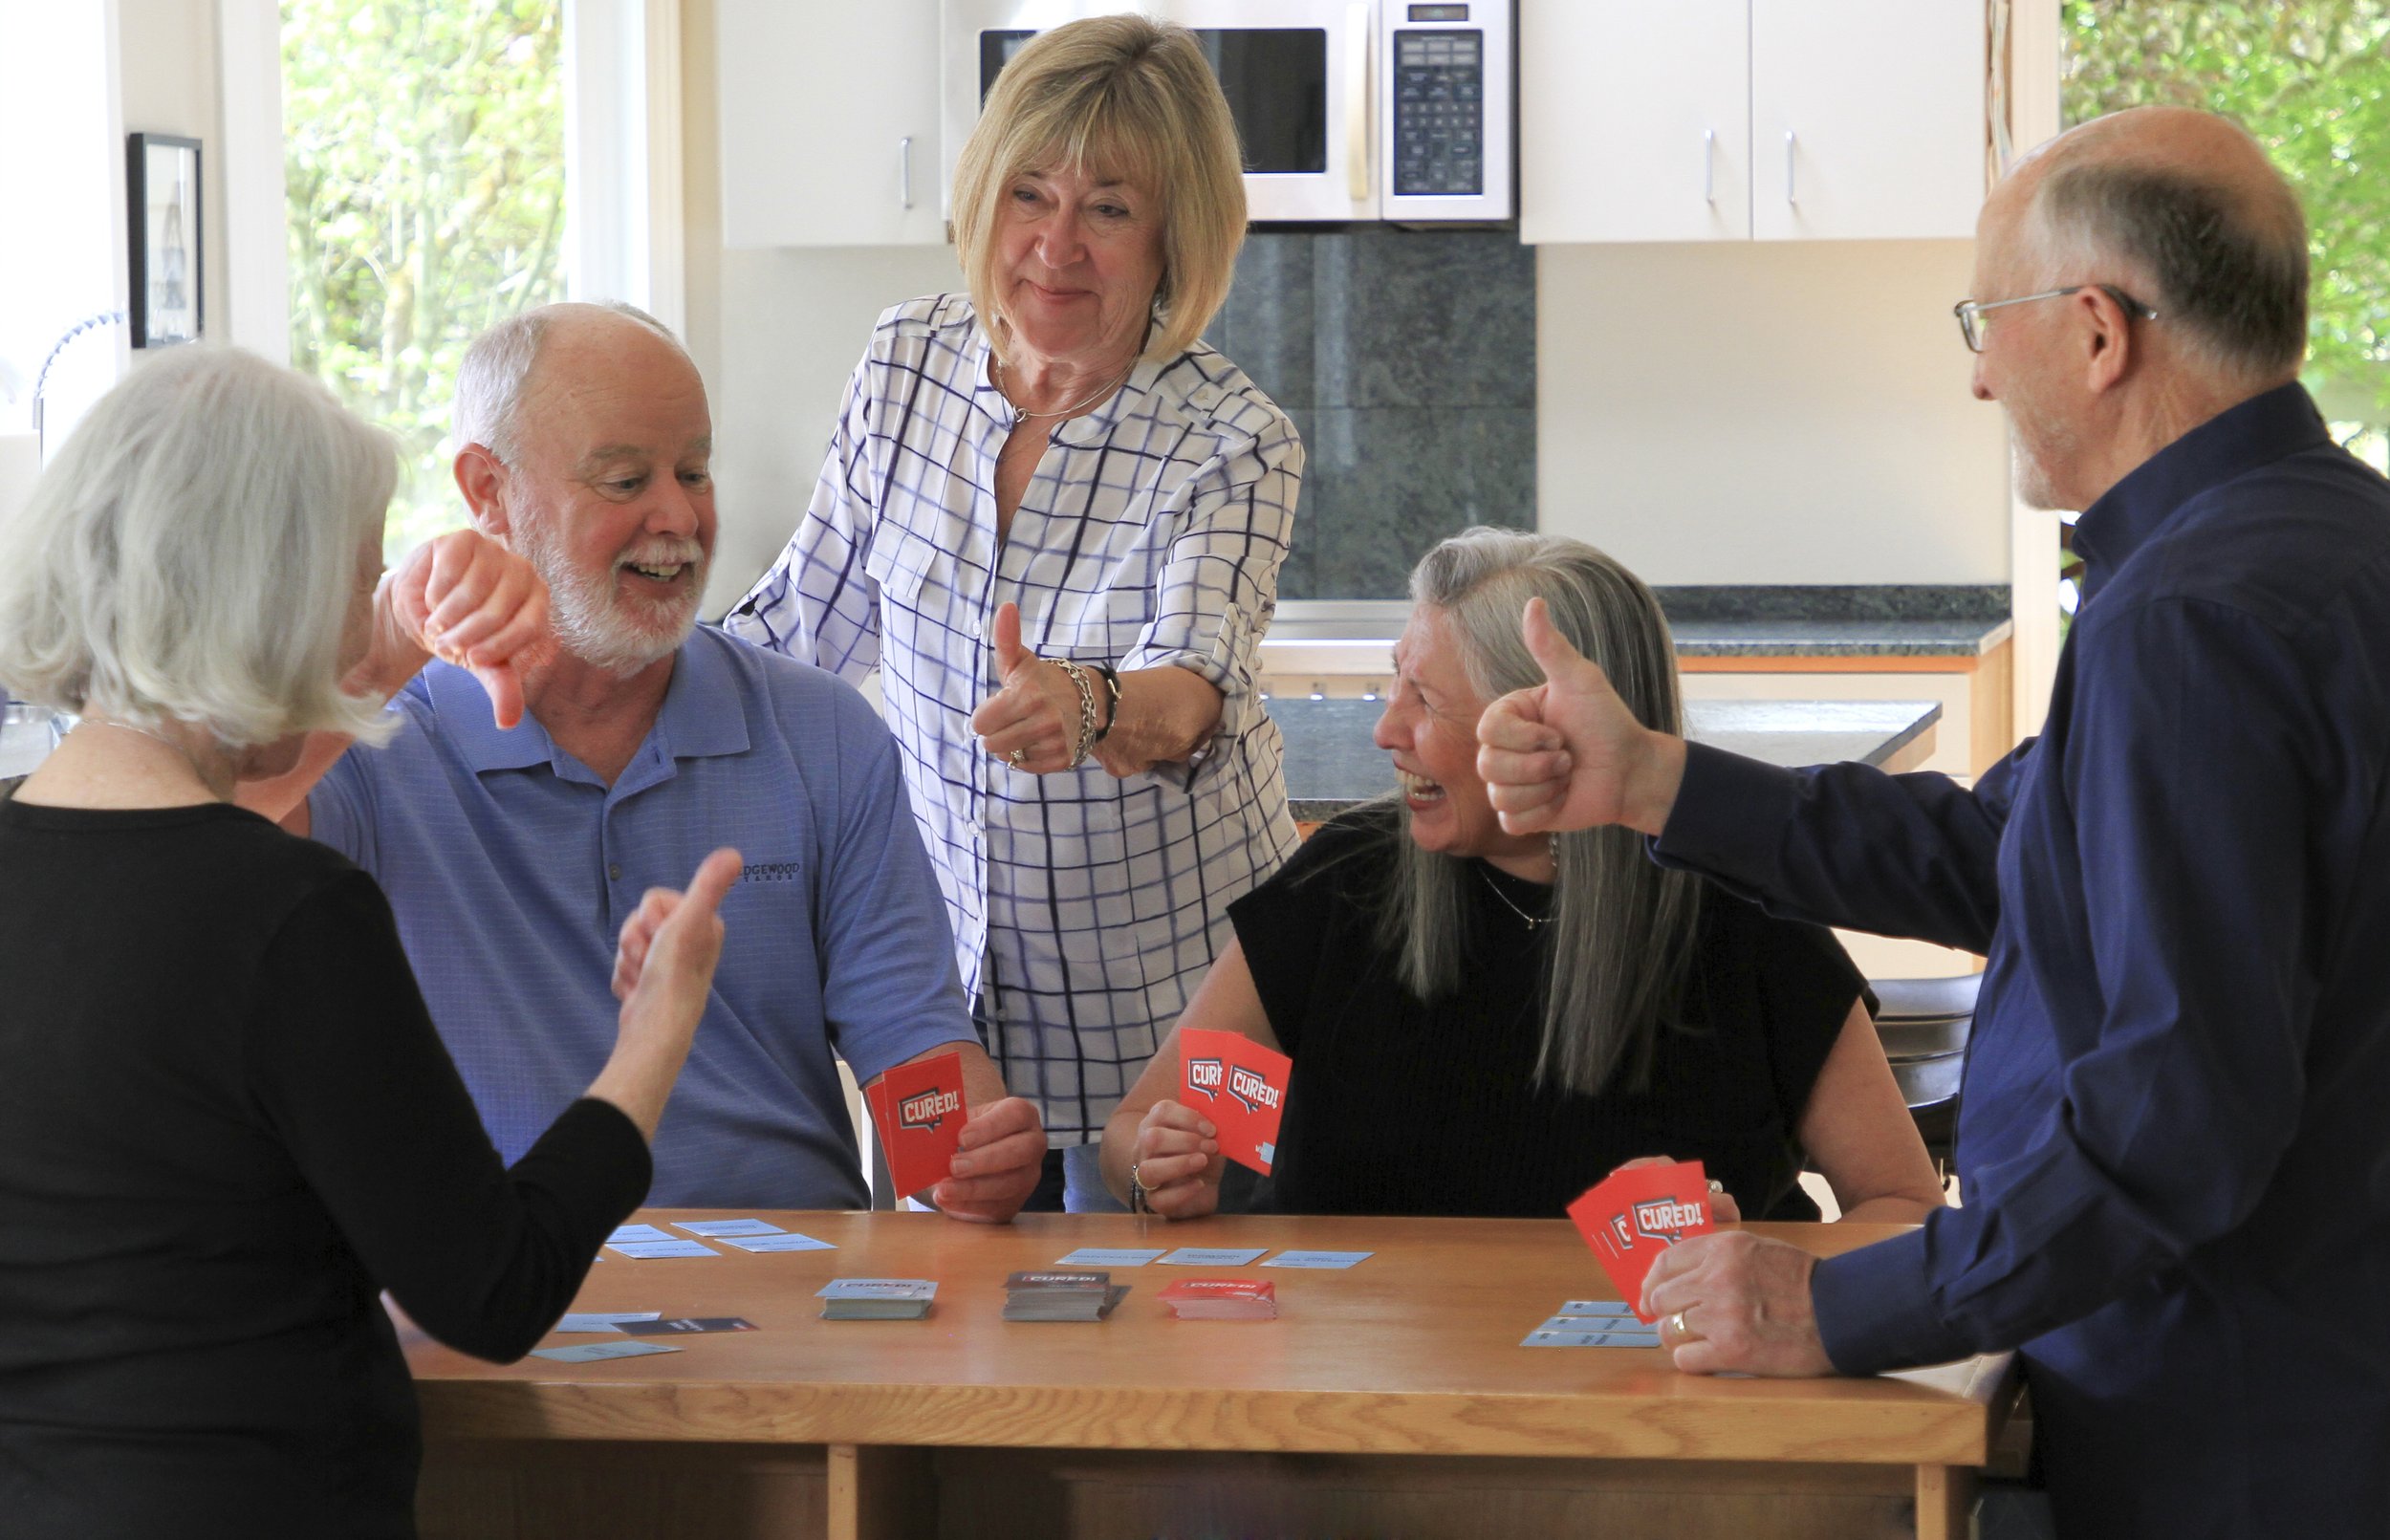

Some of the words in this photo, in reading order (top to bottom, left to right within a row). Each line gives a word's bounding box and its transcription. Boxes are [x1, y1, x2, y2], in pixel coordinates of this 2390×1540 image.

[742, 862, 800, 876] DGEWOOD
[1232, 1072, 1280, 1109] CURED!
[903, 1091, 960, 1122] CURED!
[1639, 1203, 1705, 1231] CURED!
